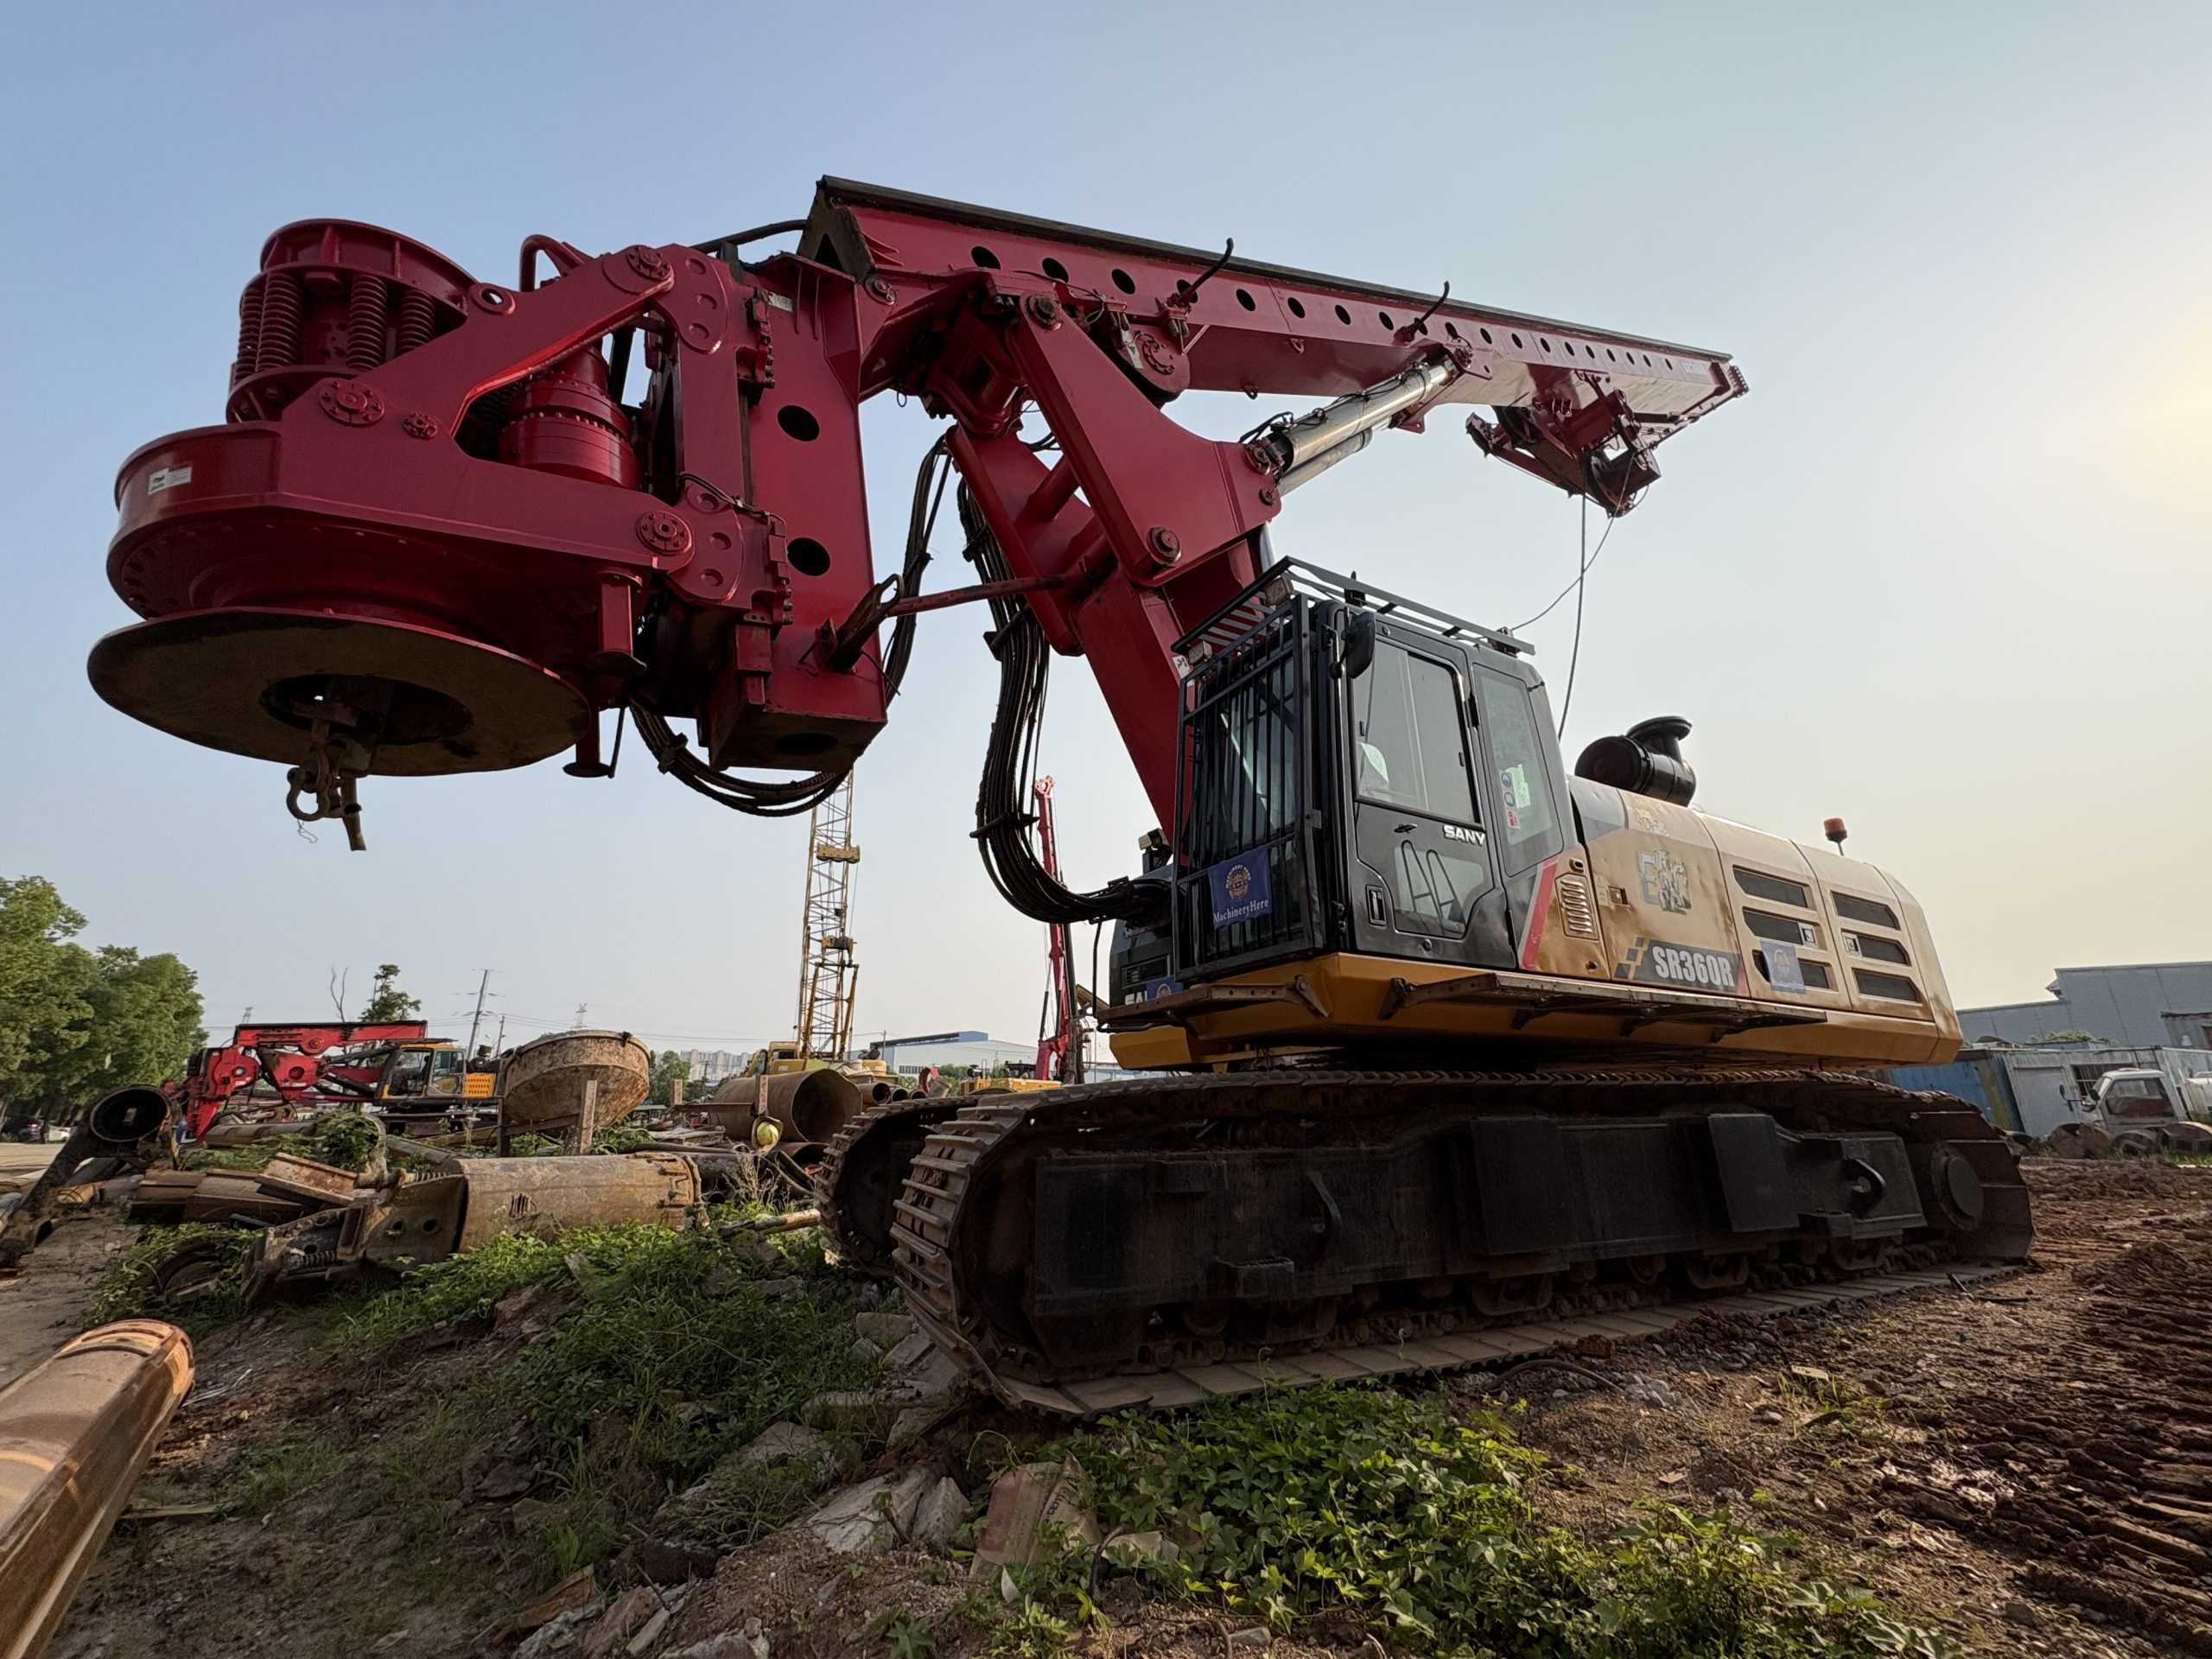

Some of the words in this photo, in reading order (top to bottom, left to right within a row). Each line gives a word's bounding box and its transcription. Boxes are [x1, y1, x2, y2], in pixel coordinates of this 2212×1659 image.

[1443, 824, 1485, 846] SANY
[1213, 899, 1269, 924] MachineryHere
[1652, 945, 1735, 988] SR360R
